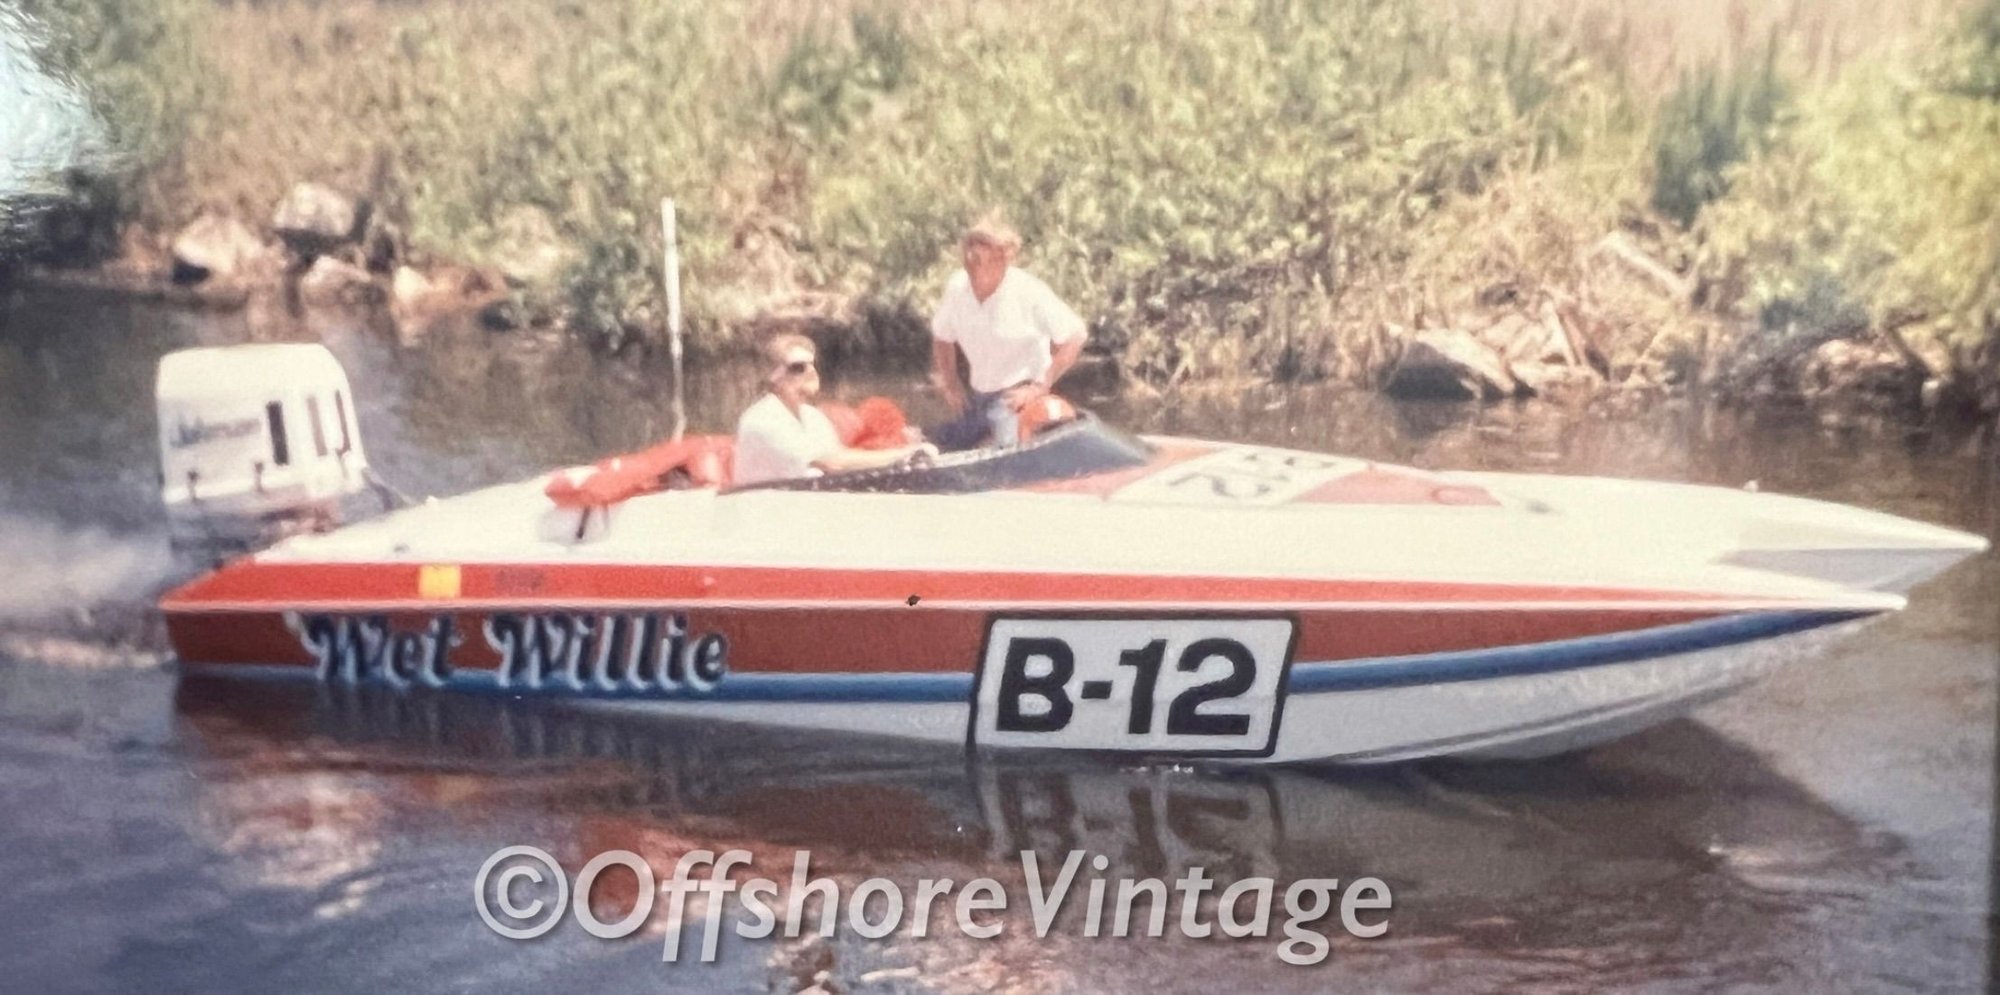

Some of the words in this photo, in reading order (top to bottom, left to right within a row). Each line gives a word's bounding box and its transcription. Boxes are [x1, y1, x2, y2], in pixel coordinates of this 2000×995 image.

[285, 610, 461, 686] Wet
[484, 612, 728, 691] Willie
[996, 637, 1256, 735] B-12
